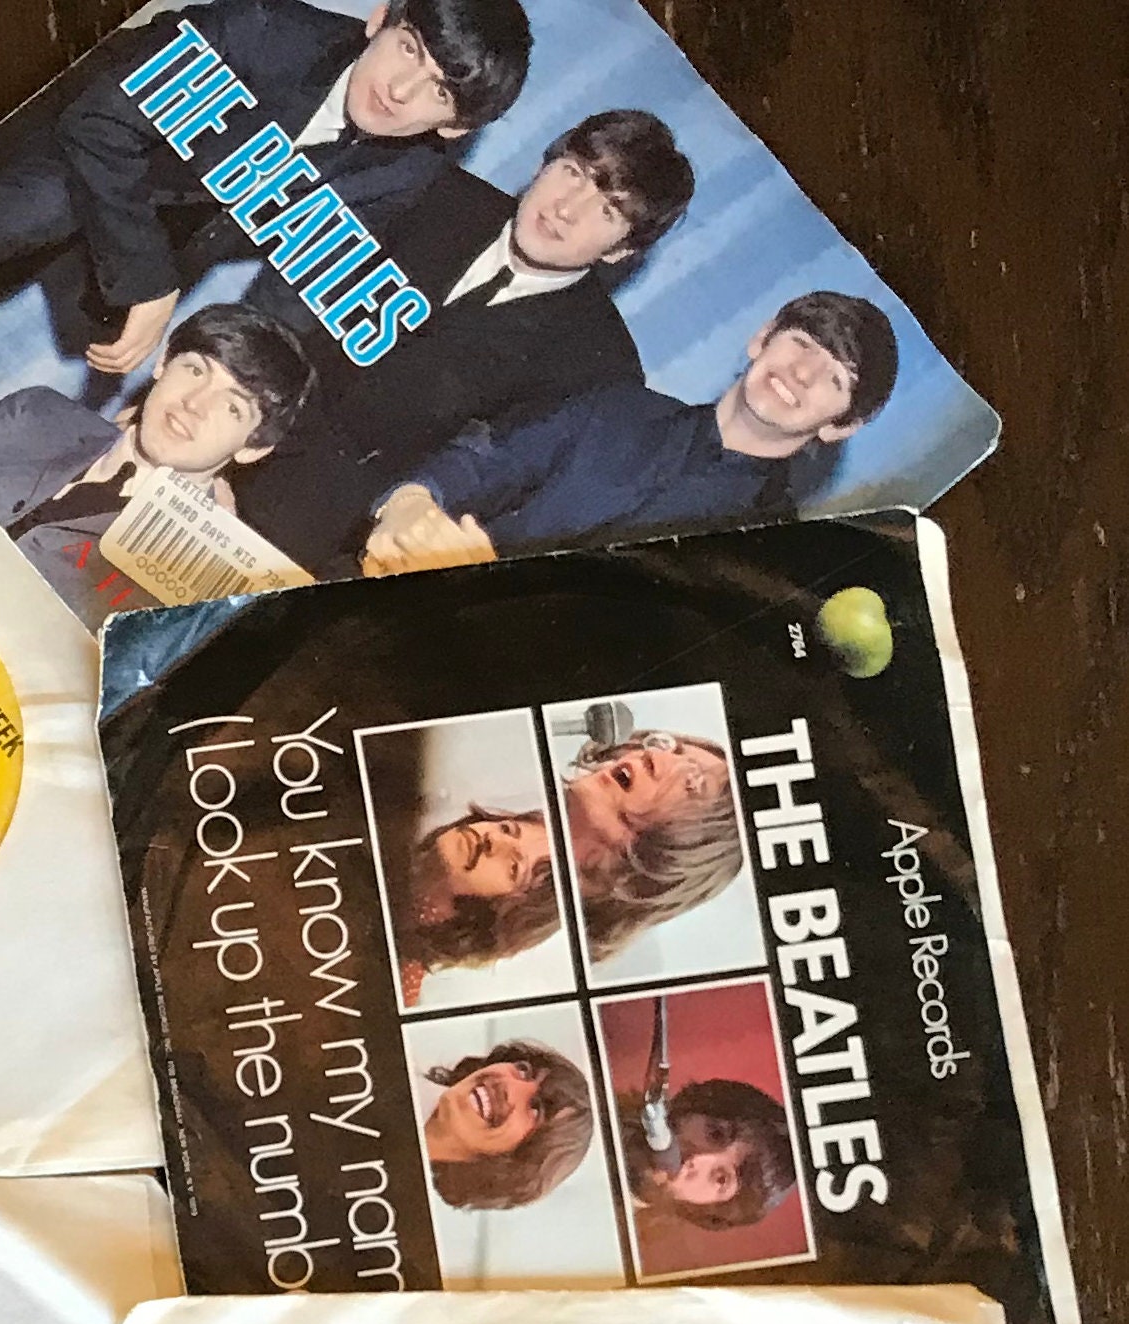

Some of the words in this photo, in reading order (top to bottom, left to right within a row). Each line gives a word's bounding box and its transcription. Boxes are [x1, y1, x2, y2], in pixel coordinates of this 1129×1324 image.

[120, 22, 258, 160] THE
[200, 121, 432, 367] BEATLES
[154, 485, 166, 498] A
[166, 495, 199, 524] HARD
[199, 521, 231, 549] DAYS
[165, 469, 218, 513] BEATLES
[787, 622, 808, 659] 2764
[167, 715, 278, 894] (Look
[270, 707, 343, 820] You
[740, 717, 830, 870] THE
[289, 837, 363, 1018] know
[880, 818, 943, 929] Apple
[152, 968, 163, 993] APPLE
[192, 902, 265, 982] up
[225, 998, 304, 1097] the
[766, 888, 889, 1214] BEATLES
[907, 934, 969, 1080] Records
[310, 1039, 381, 1138] my
[244, 1115, 341, 1294] numb
[340, 1160, 404, 1292] nam
